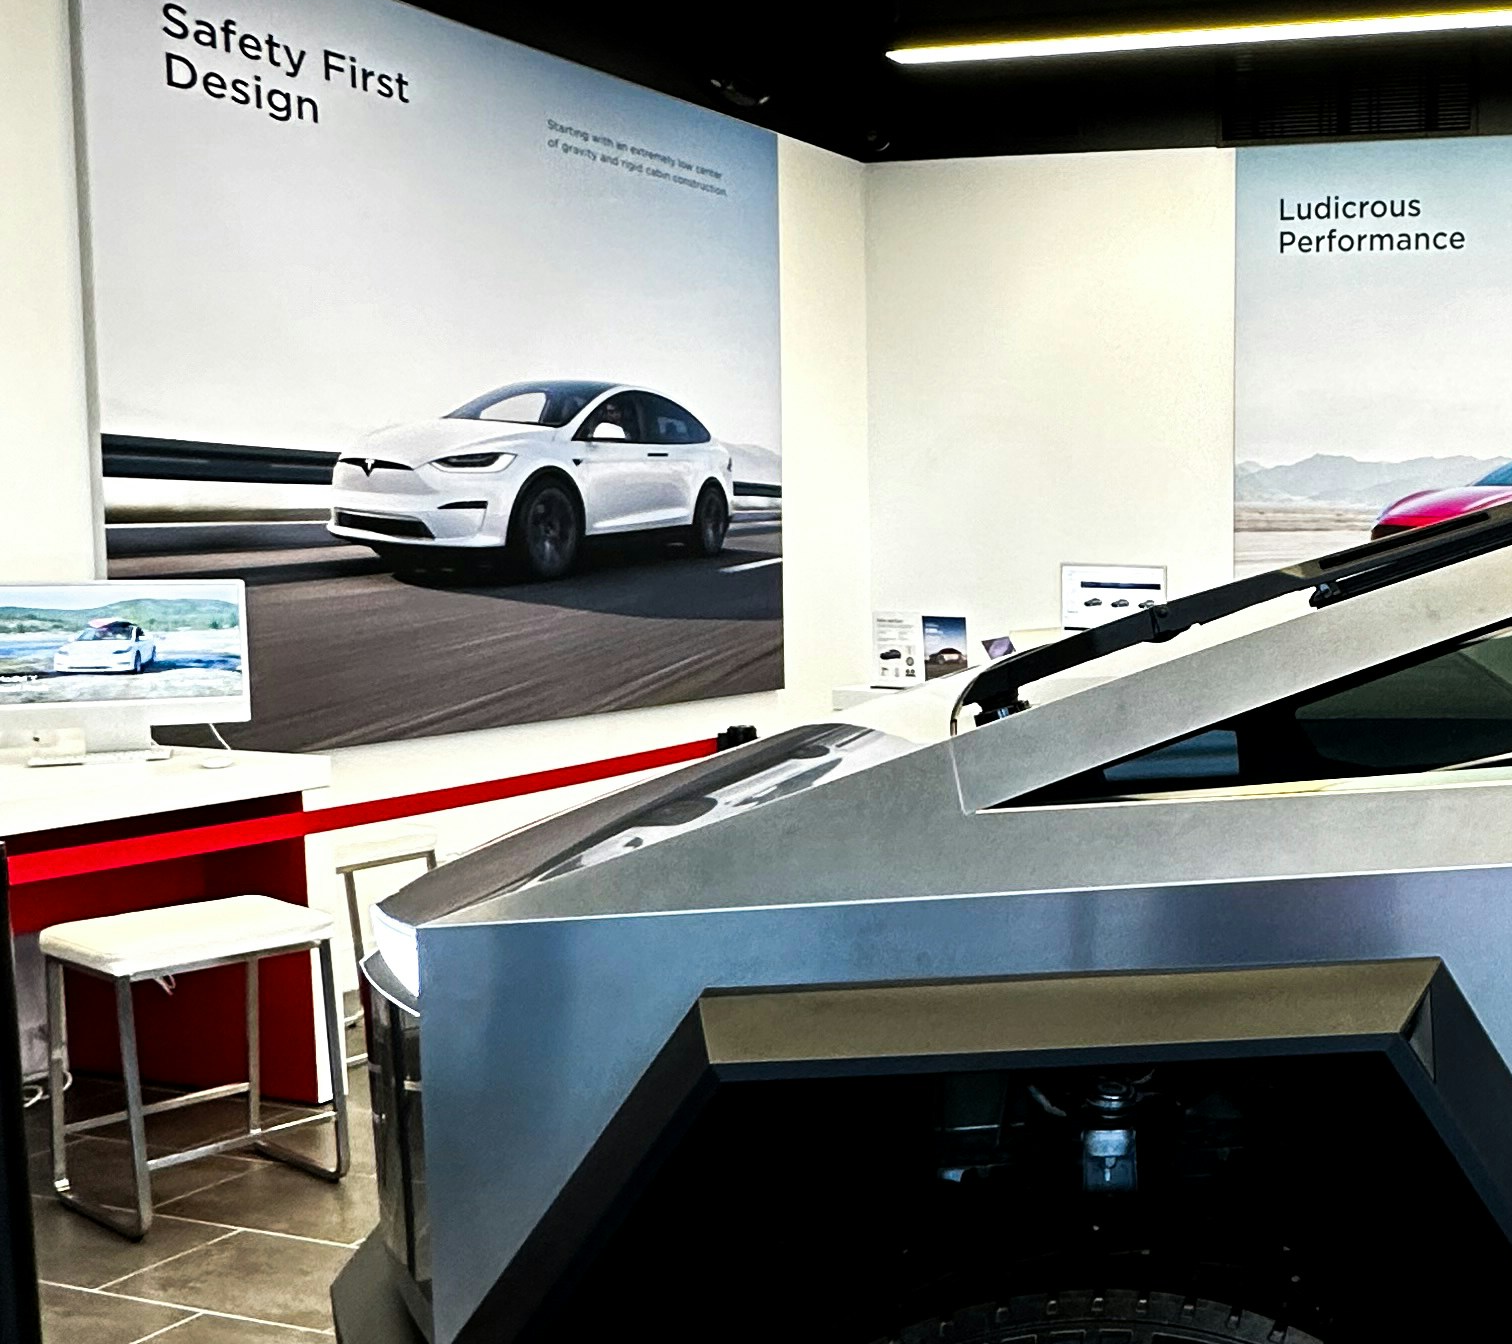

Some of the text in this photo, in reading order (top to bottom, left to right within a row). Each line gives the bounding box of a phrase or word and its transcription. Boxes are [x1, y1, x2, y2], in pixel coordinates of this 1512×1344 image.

[161, 2, 410, 104] Safety First
[164, 51, 320, 124] Design
[547, 118, 590, 143] Starting
[592, 134, 614, 149] with
[547, 138, 560, 149] of
[561, 142, 597, 162] gravity
[600, 154, 619, 167] and
[1279, 195, 1422, 221] Ludicrous
[1279, 228, 1466, 254] Performance
